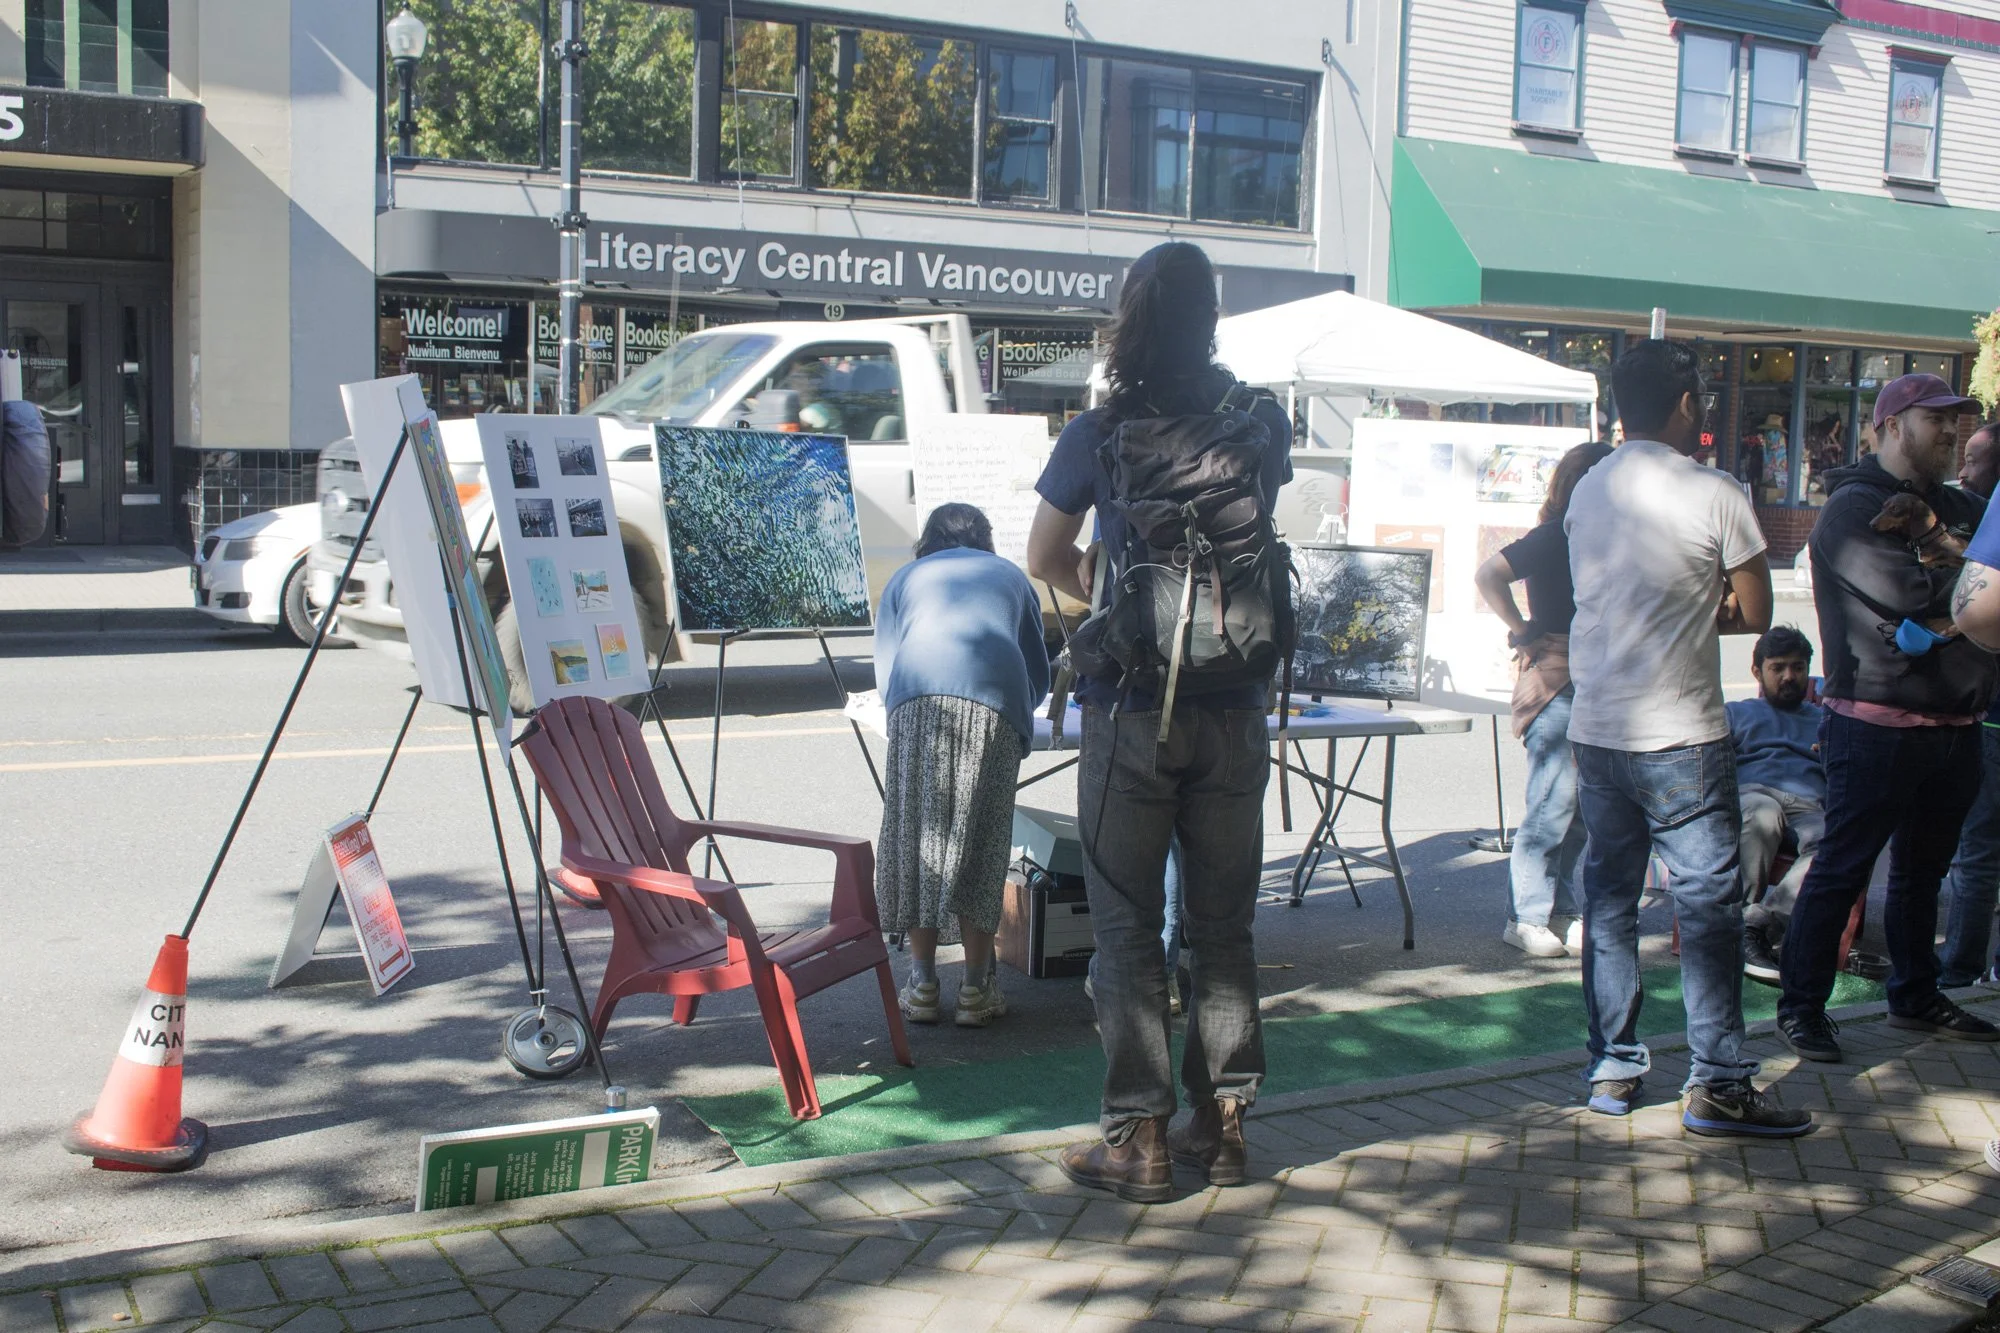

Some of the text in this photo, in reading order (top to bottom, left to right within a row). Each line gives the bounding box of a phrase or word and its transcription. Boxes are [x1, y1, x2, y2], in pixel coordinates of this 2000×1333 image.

[583, 232, 746, 284] iteracy
[758, 242, 904, 288] Central
[918, 252, 1112, 299] Vancouver
[827, 305, 842, 319] 19
[404, 308, 502, 338] Welcome!
[538, 315, 614, 343] Bostore
[454, 345, 500, 360] Bienvenu
[538, 346, 558, 357] Well
[585, 348, 613, 361] Books
[625, 351, 644, 362] Well
[1002, 340, 1088, 363] Bookstore
[1003, 367, 1025, 377] Well
[1699, 432, 1713, 446] EN
